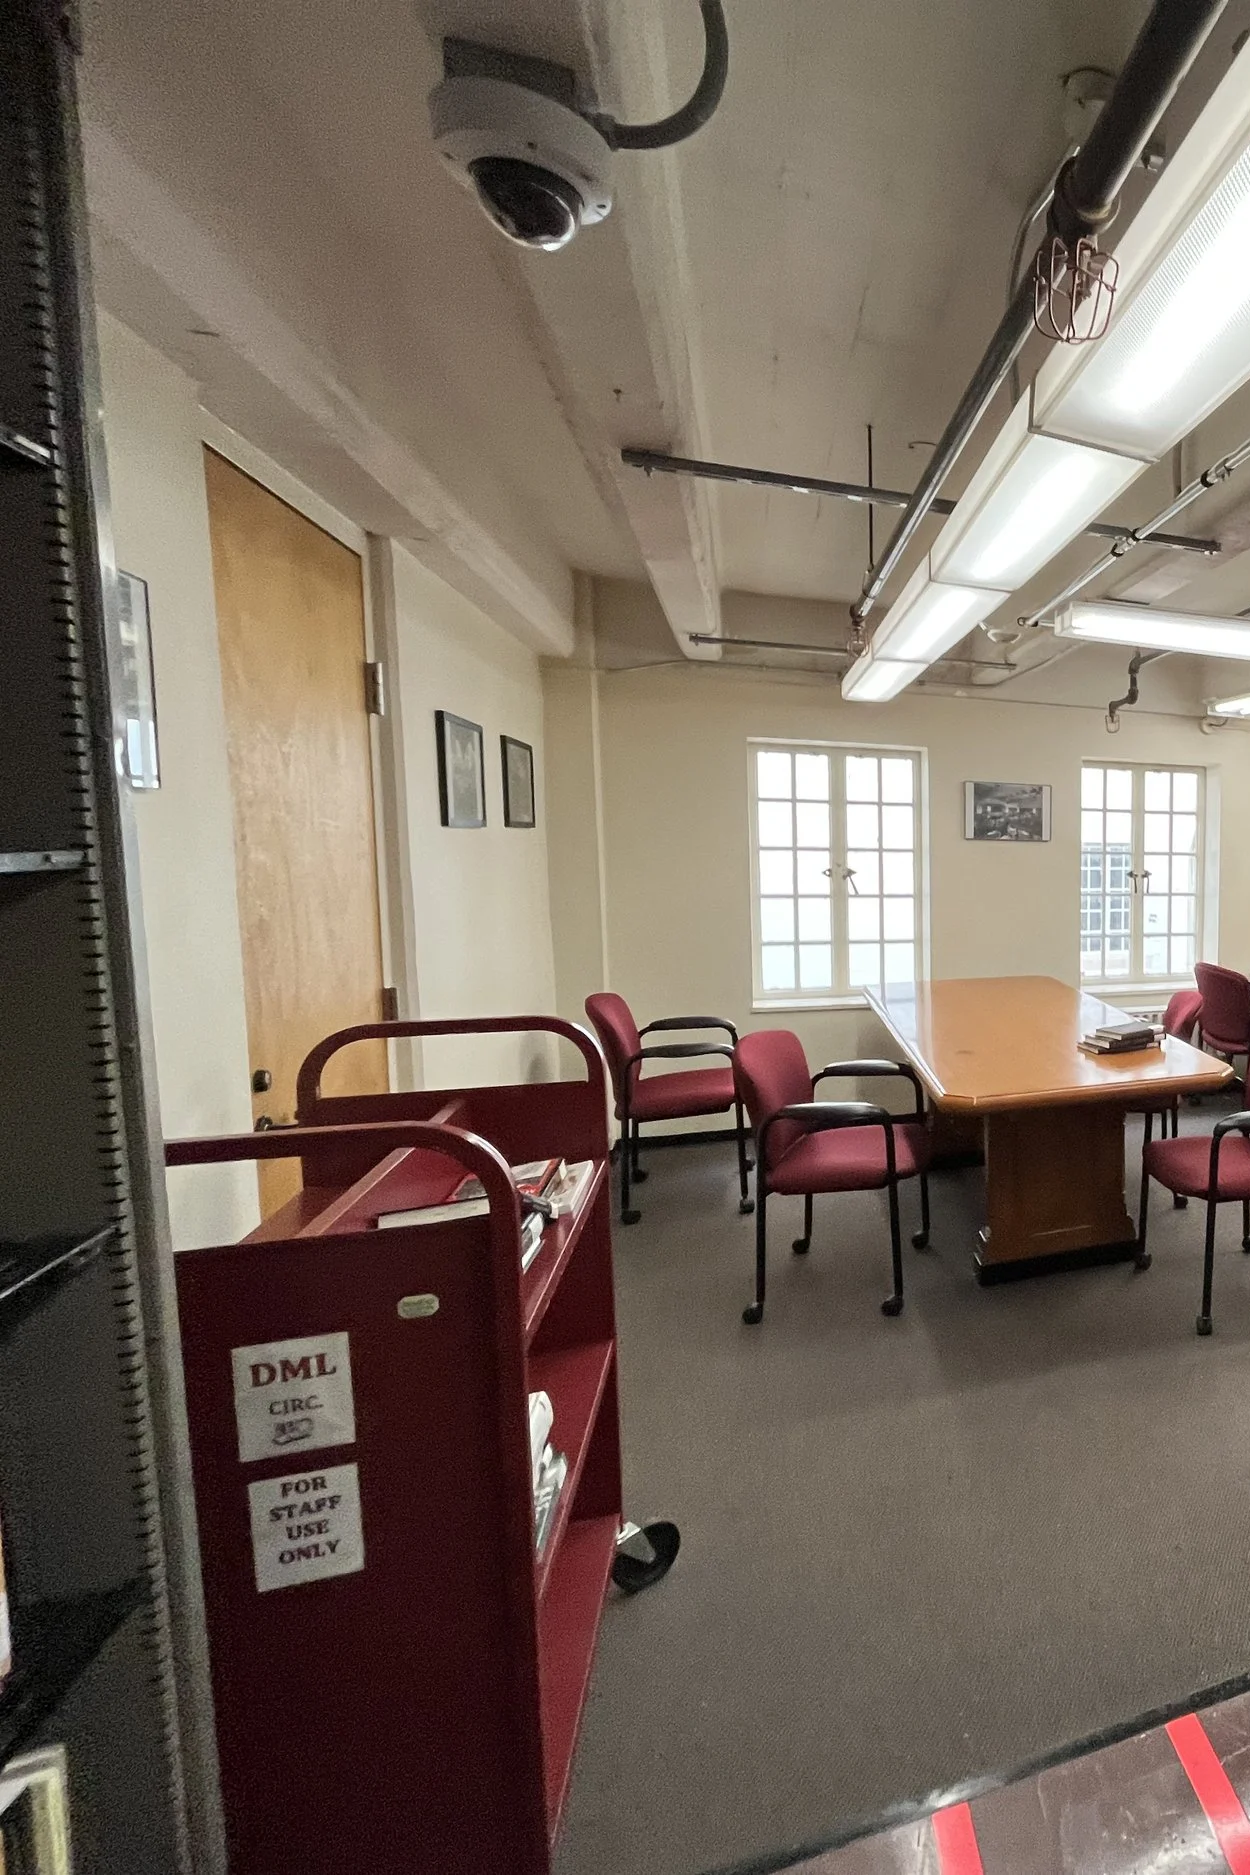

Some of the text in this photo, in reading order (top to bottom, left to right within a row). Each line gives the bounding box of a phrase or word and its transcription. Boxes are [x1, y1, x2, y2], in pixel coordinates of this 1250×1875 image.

[250, 1353, 337, 1388] DML
[280, 1476, 328, 1498] FOR
[268, 1495, 342, 1522] STAFF
[286, 1519, 331, 1540] USE
[278, 1539, 340, 1564] ONLY
